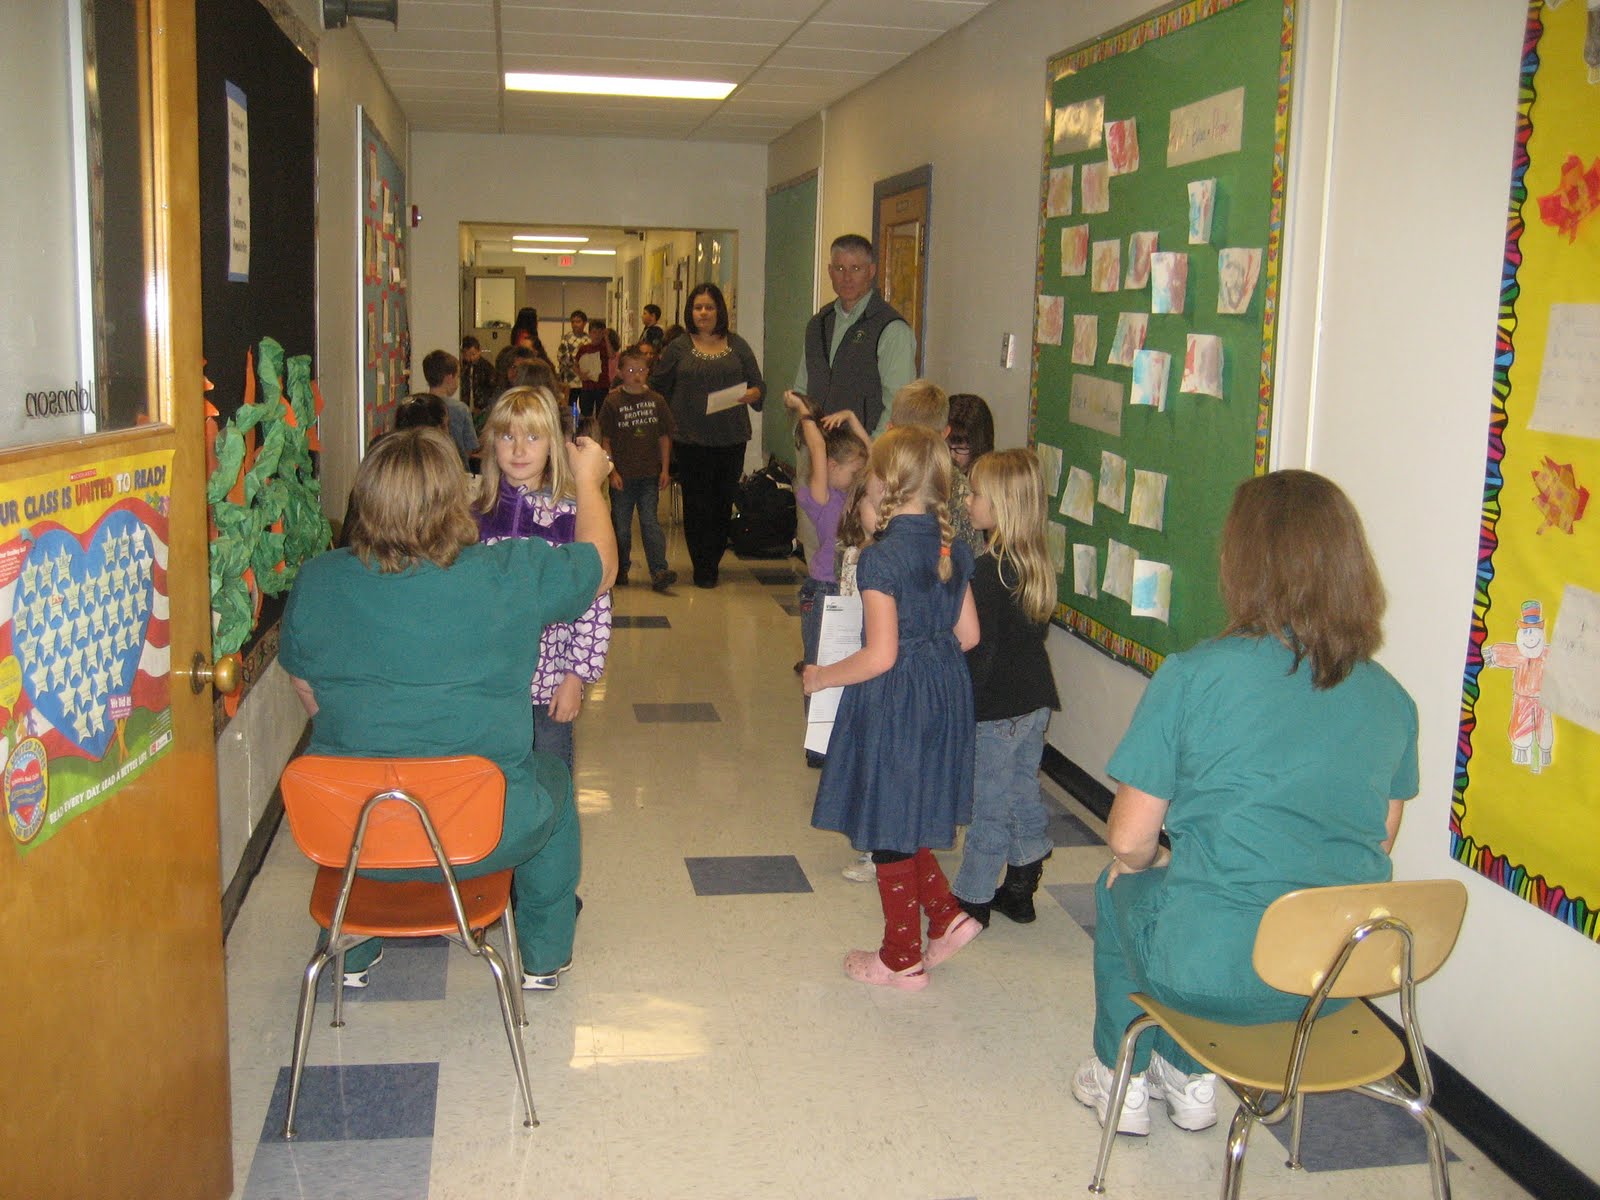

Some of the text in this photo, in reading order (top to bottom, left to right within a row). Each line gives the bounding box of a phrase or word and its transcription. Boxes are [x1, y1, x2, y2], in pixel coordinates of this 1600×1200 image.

[618, 400, 657, 413] WILL TRADE
[623, 409, 654, 420] BROTHER
[24, 488, 59, 520] CLASS
[62, 486, 72, 509] IS
[75, 477, 114, 506] UNITED
[116, 473, 131, 493] TO
[134, 465, 167, 491] READ!
[49, 807, 64, 825] READ
[63, 791, 85, 813] EVERY
[101, 774, 116, 792] READ
[116, 771, 122, 783] A
[121, 759, 139, 780] BETTER
